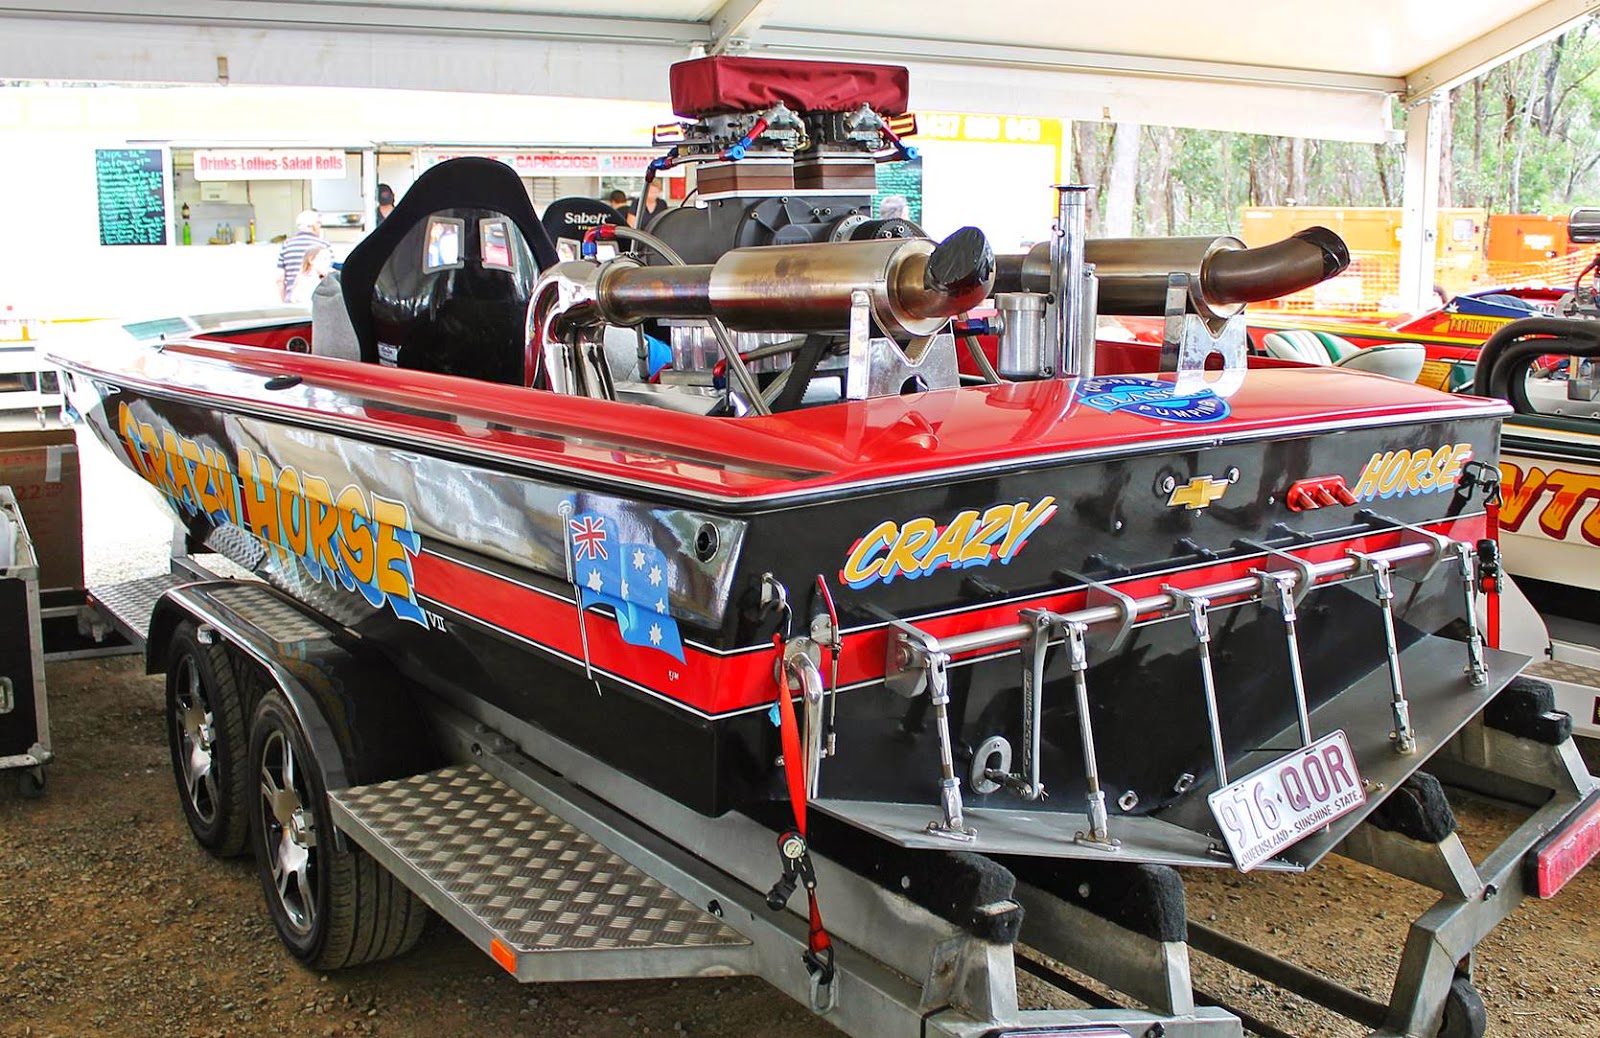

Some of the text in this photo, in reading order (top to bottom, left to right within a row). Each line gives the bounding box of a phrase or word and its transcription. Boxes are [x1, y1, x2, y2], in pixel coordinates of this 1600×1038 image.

[316, 156, 342, 169] Rolls
[516, 155, 599, 168] CAPRICCIOSA
[564, 212, 607, 224] Sabelt
[1351, 443, 1473, 502] HORSE
[118, 400, 427, 626] CRAZY HORSE
[839, 495, 1058, 589] CRAZY
[428, 612, 446, 631] VII
[1241, 790, 1359, 863] QUEENSLAND SUNSHINE STATE
